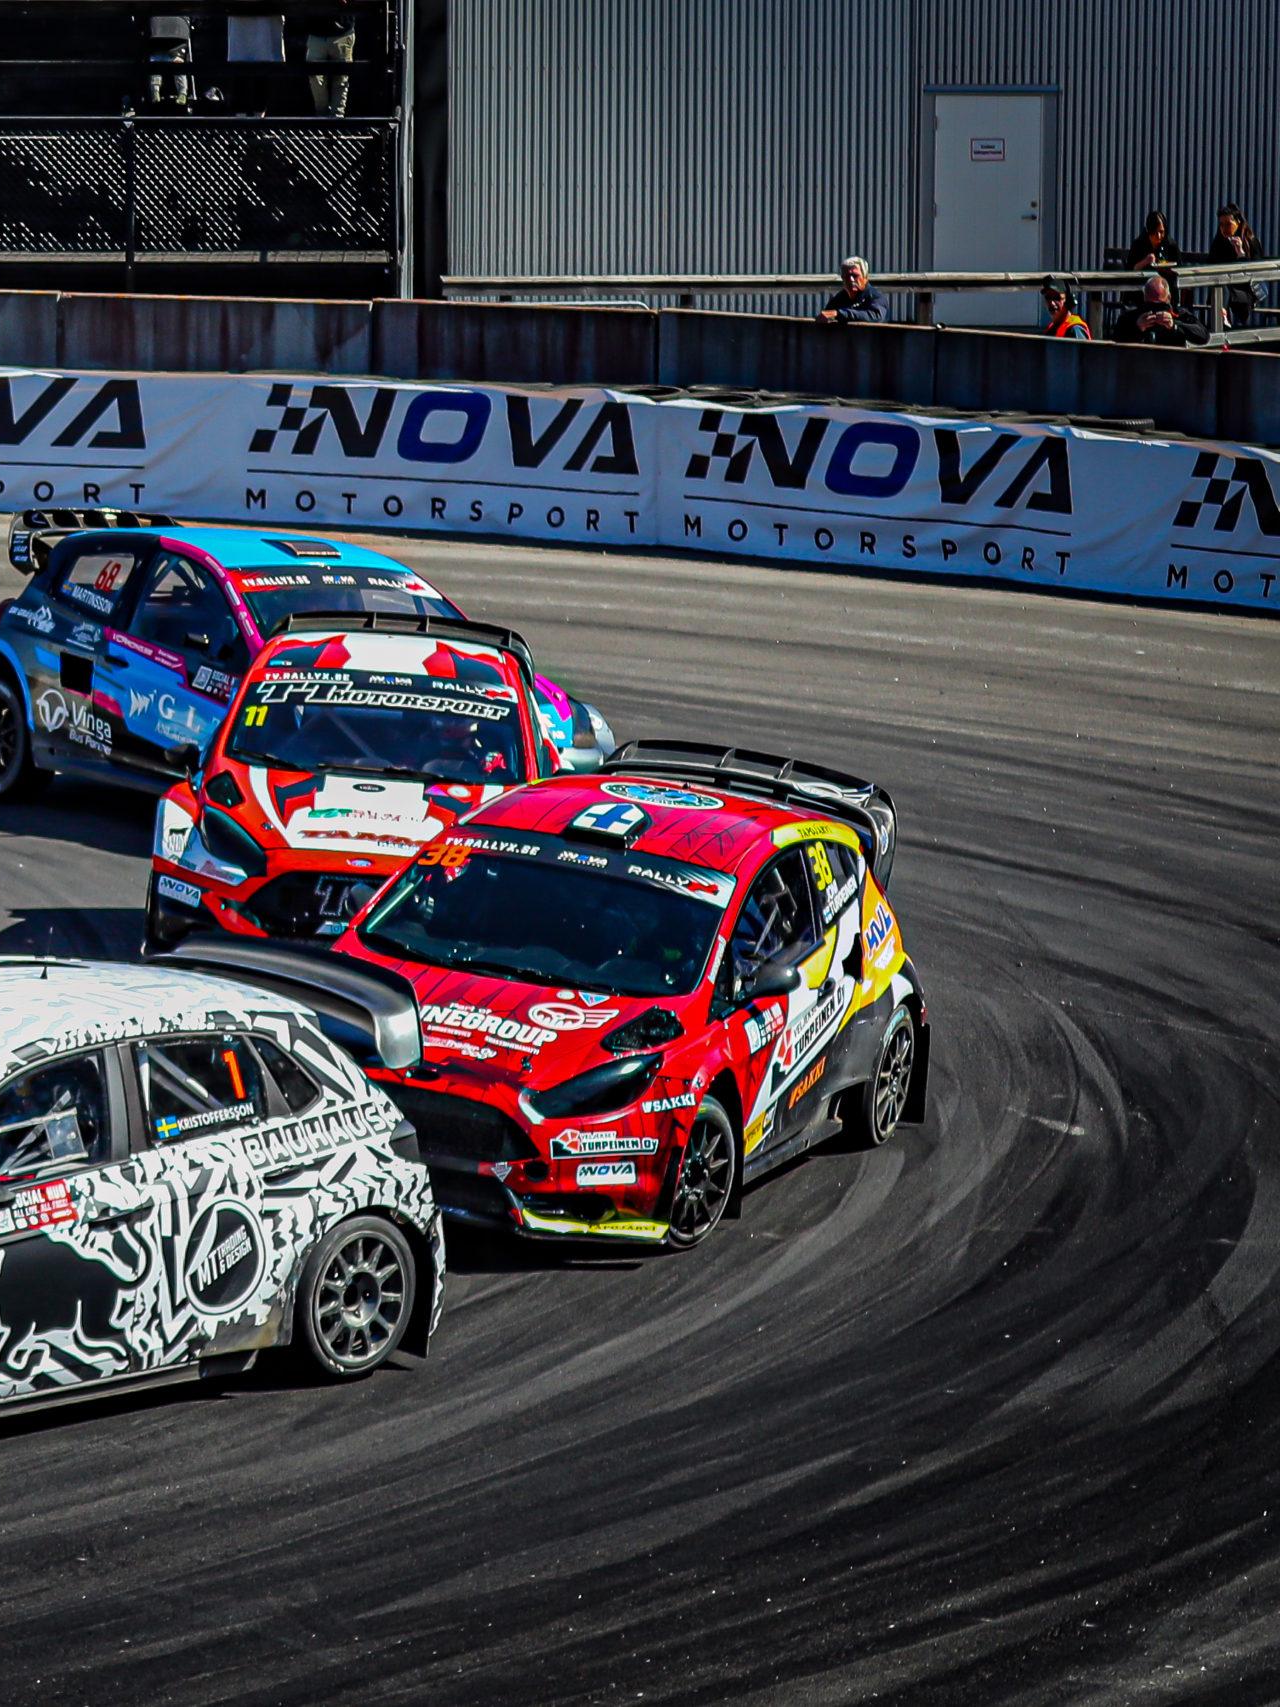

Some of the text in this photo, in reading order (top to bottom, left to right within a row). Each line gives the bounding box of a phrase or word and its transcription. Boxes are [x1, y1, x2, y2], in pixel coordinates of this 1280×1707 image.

[248, 383, 639, 475] NOVA
[685, 408, 1073, 515] NOVA
[245, 487, 640, 534] MOTORSPORT
[683, 514, 1073, 576] MOTORSPORT
[93, 560, 121, 593] 68
[72, 701, 112, 740] Vinga
[244, 705, 269, 727] 11
[417, 844, 471, 868] 38
[807, 841, 833, 891] 38
[795, 997, 836, 1061] TURPEINEN
[222, 1050, 246, 1099] 1
[177, 1103, 255, 1132] KRISTOFFERSSON
[244, 1105, 390, 1167] BAUHAUS
[581, 1139, 639, 1151] TURPEINEN
[579, 1163, 633, 1177] NOVA
[217, 1224, 247, 1260] TRADING
[225, 1236, 253, 1270] DESIGN
[197, 1249, 218, 1292] MT
